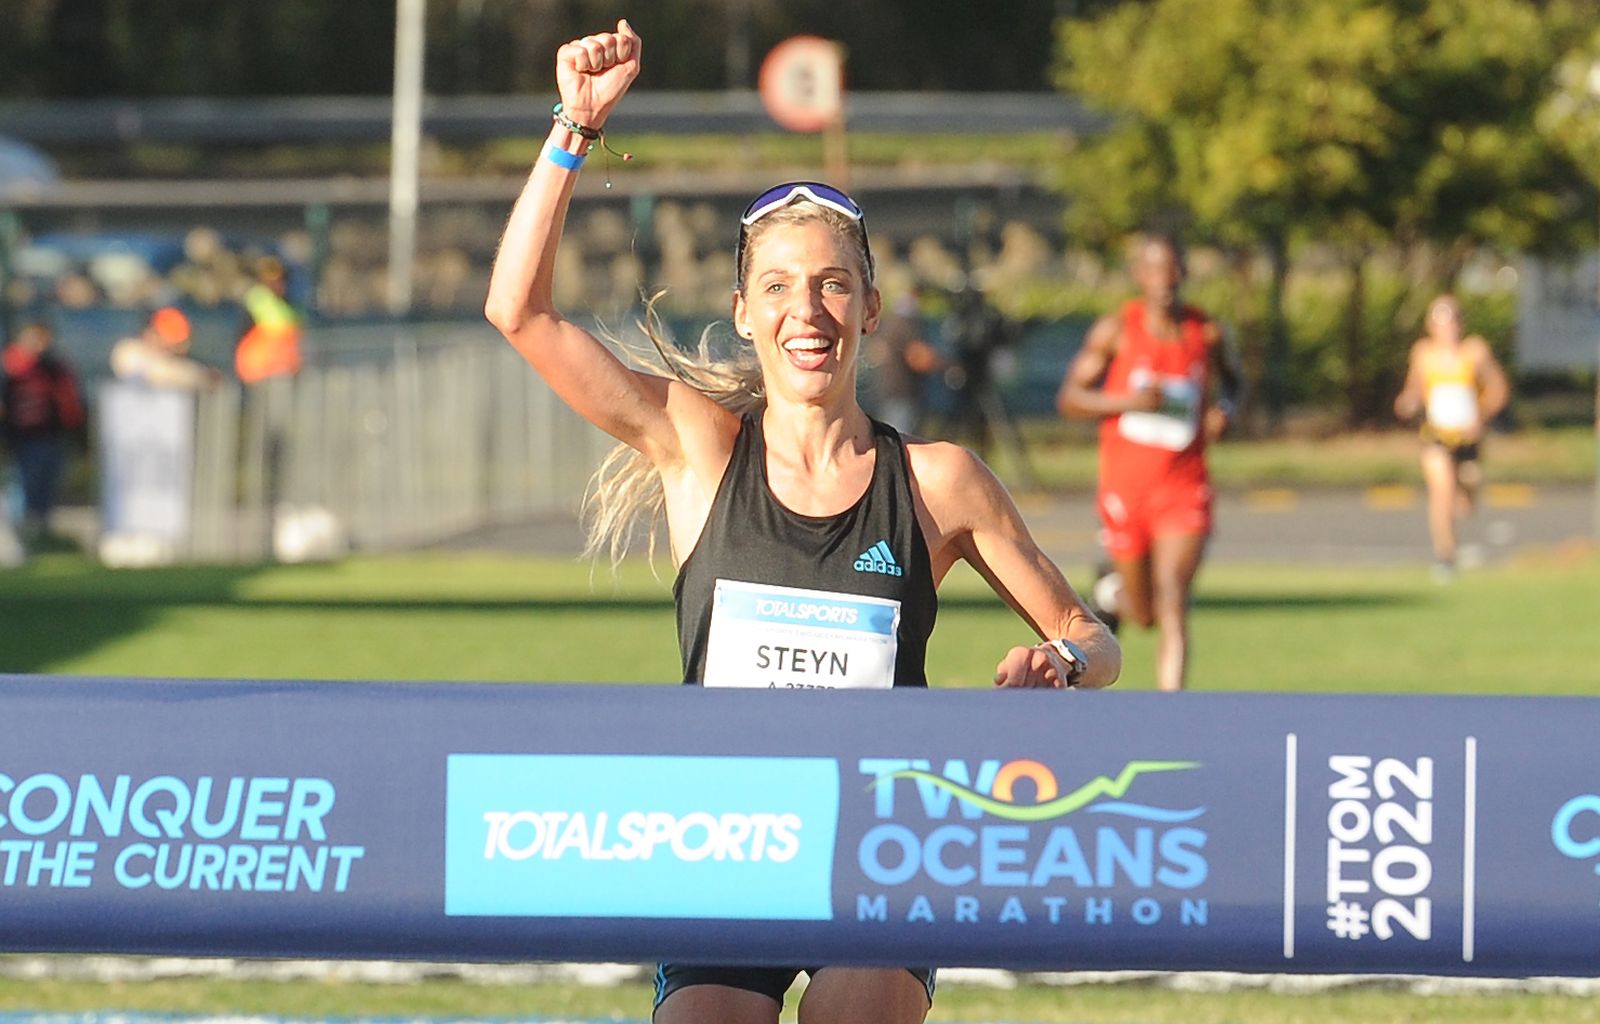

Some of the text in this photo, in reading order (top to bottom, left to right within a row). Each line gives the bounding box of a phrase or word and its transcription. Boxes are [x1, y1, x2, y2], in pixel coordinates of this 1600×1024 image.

[853, 559, 902, 577] adidas
[755, 599, 859, 625] TOTALSPORTS
[756, 644, 848, 676] STEYN
[0, 773, 336, 841] ONQUER
[858, 758, 1057, 820] TWO
[483, 811, 803, 863] TOTALSPORTS
[858, 824, 1208, 889] OCEANS
[1326, 755, 1372, 940] #TTOM
[1371, 757, 1433, 940] 2022
[0, 840, 364, 892] THE CURRENT
[856, 895, 1208, 925] MARATHON
